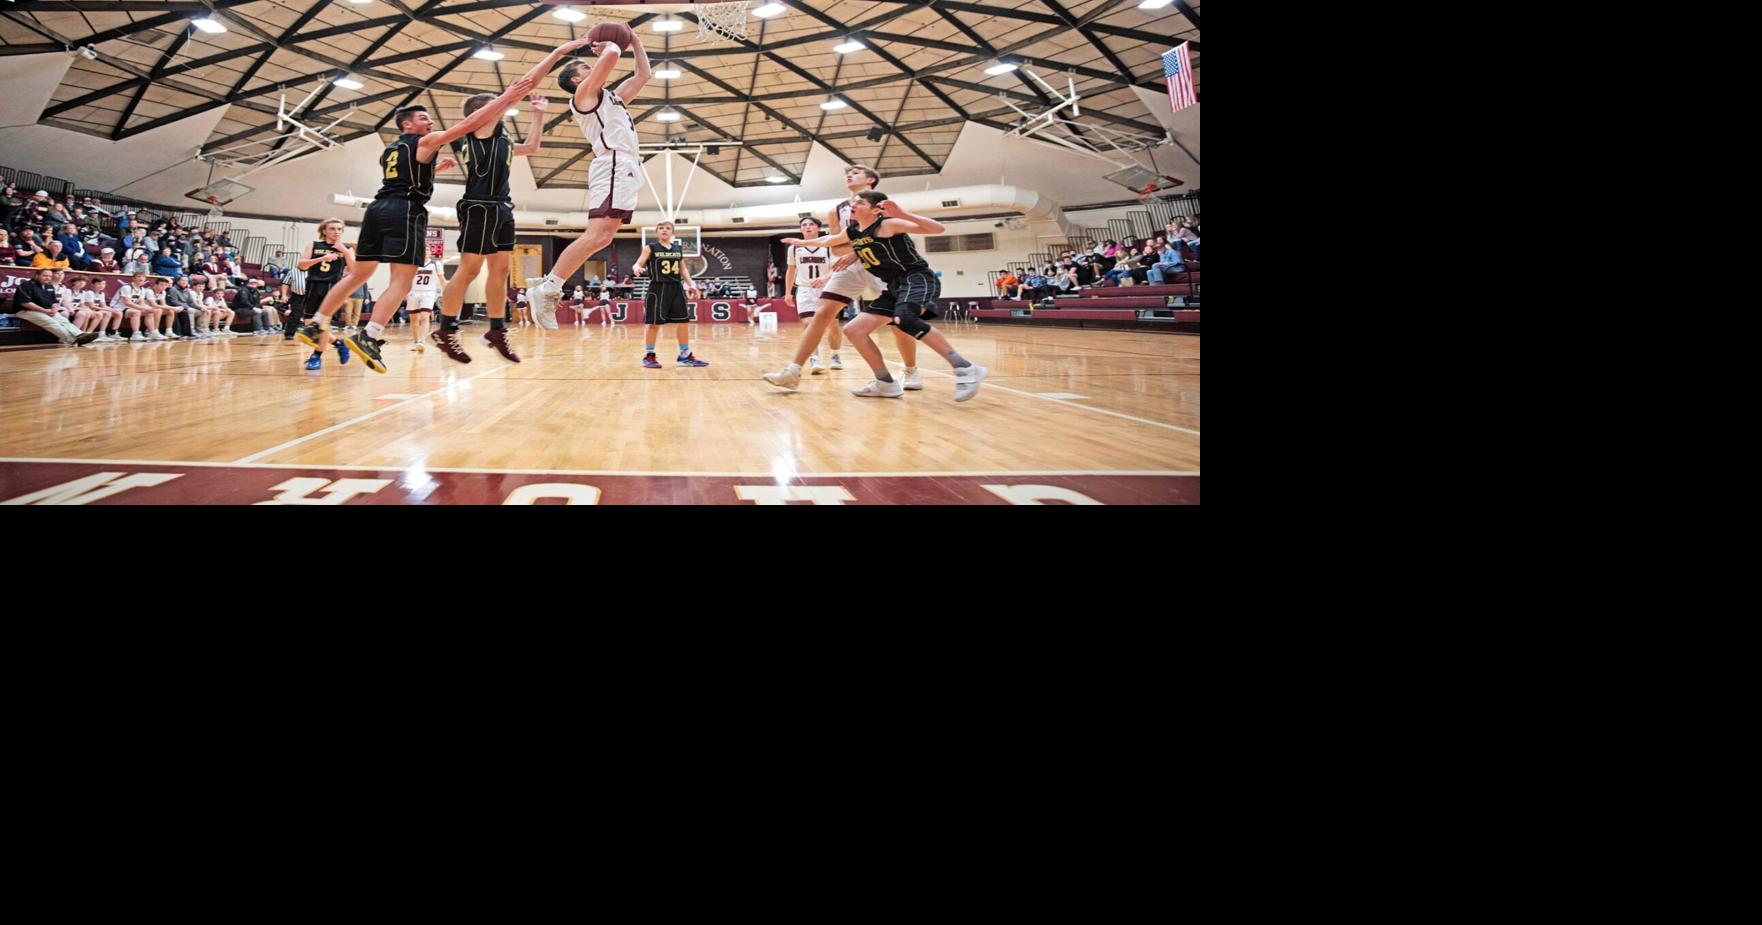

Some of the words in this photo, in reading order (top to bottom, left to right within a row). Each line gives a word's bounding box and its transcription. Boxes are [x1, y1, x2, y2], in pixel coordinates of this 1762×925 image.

[702, 242, 733, 270] NATION
[320, 260, 331, 273] 5
[661, 260, 680, 275] 34
[808, 264, 820, 279] 11
[416, 275, 430, 285] 20
